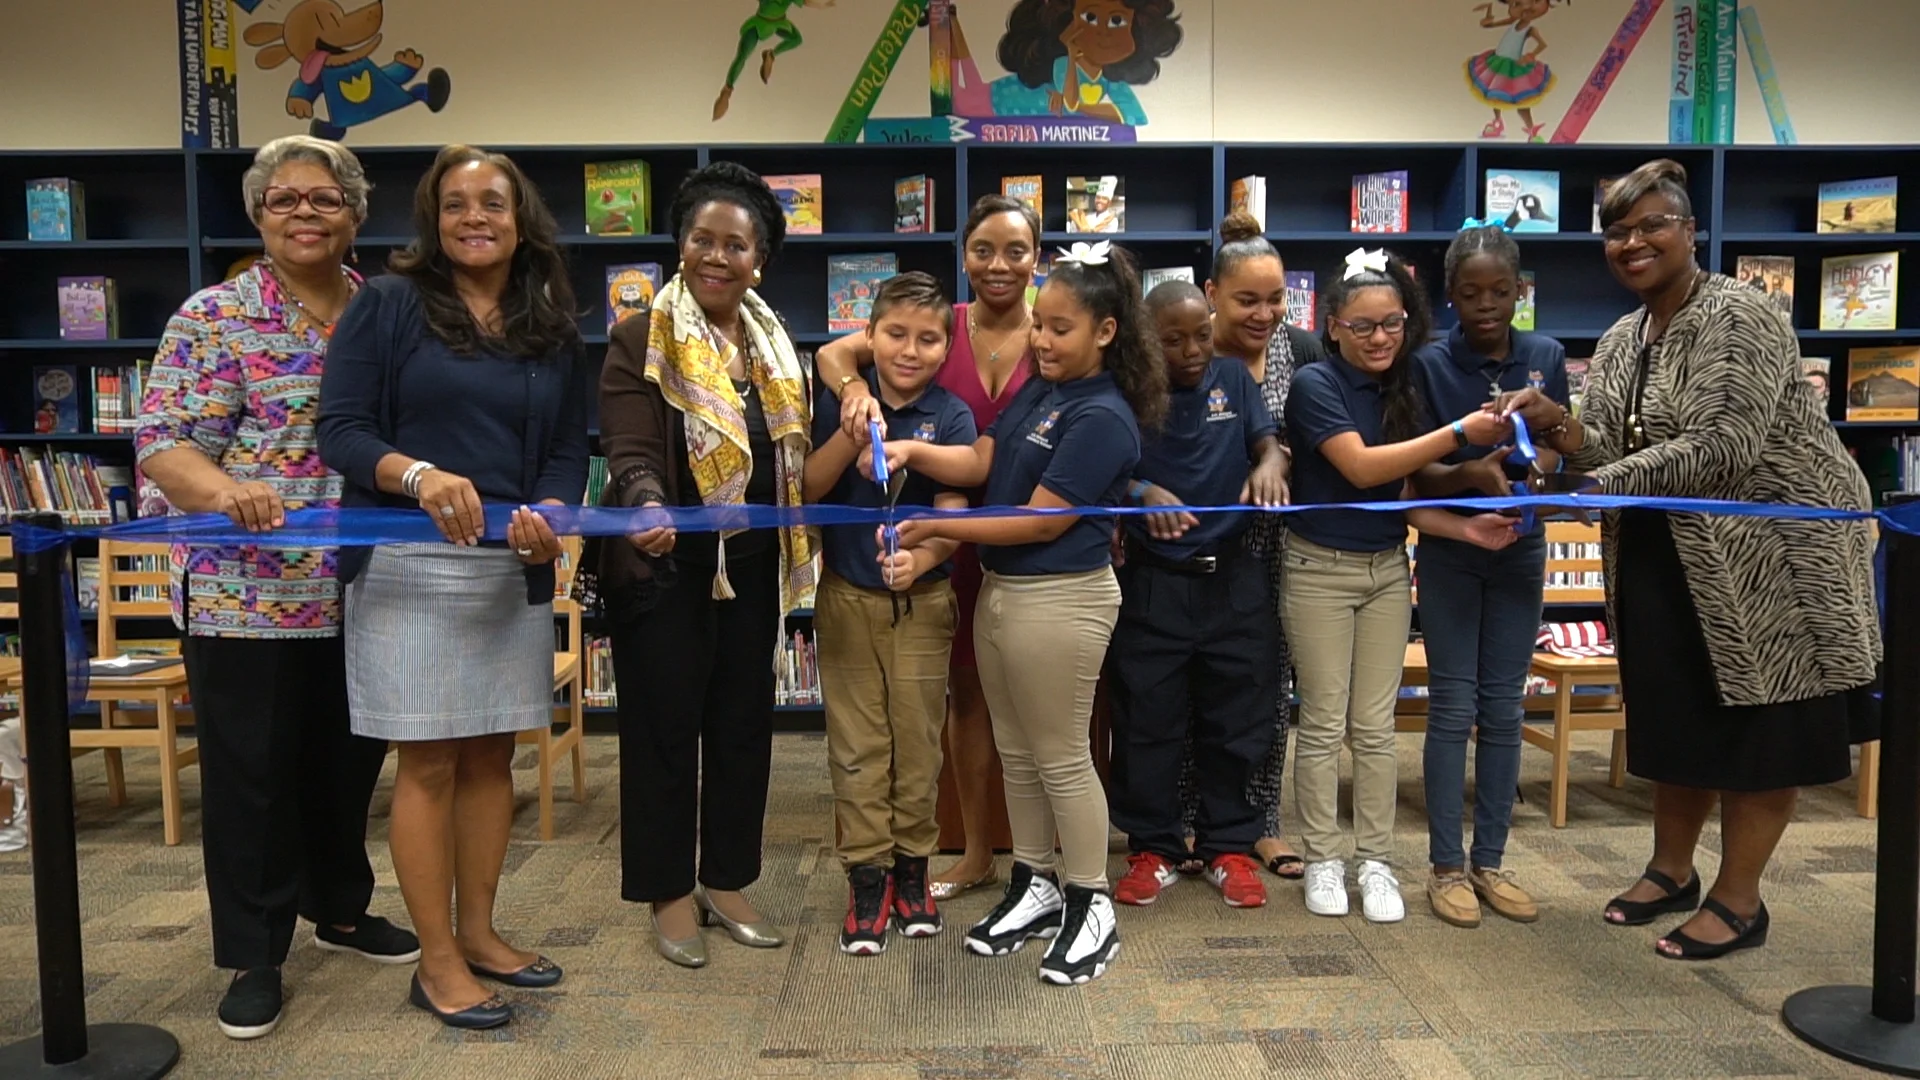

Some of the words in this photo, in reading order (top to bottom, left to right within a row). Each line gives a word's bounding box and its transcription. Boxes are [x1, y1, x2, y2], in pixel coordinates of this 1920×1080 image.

[213, 20, 230, 50] MAN
[877, 3, 920, 67] Peter
[1717, 1, 1734, 30] Am
[1674, 6, 1695, 97] Firebird
[1715, 32, 1736, 92] Malala
[184, 42, 200, 136] UNDERPANTS
[981, 123, 1039, 143] SOFIA
[1041, 125, 1111, 143] MARTINEZ
